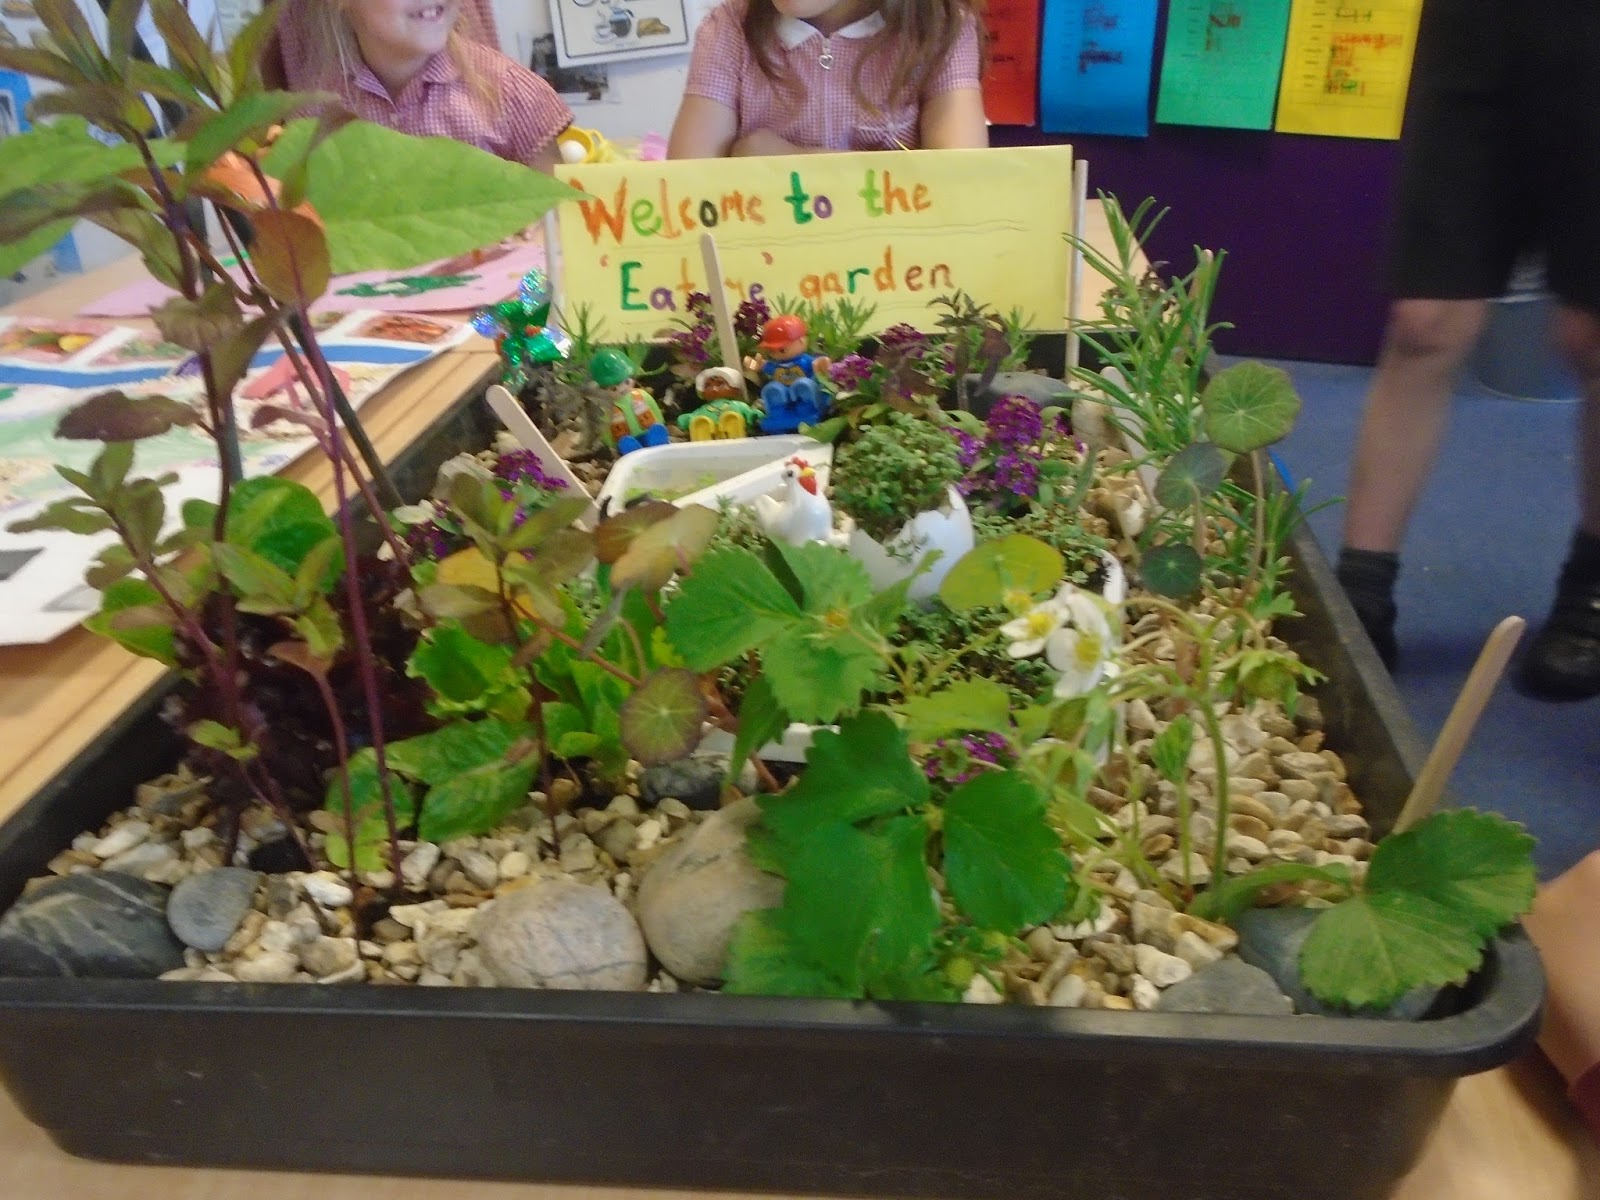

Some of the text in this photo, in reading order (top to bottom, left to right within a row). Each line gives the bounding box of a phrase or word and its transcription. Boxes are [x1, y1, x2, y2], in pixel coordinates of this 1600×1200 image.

[569, 168, 931, 245] Welcome to the
[799, 244, 955, 312] garden
